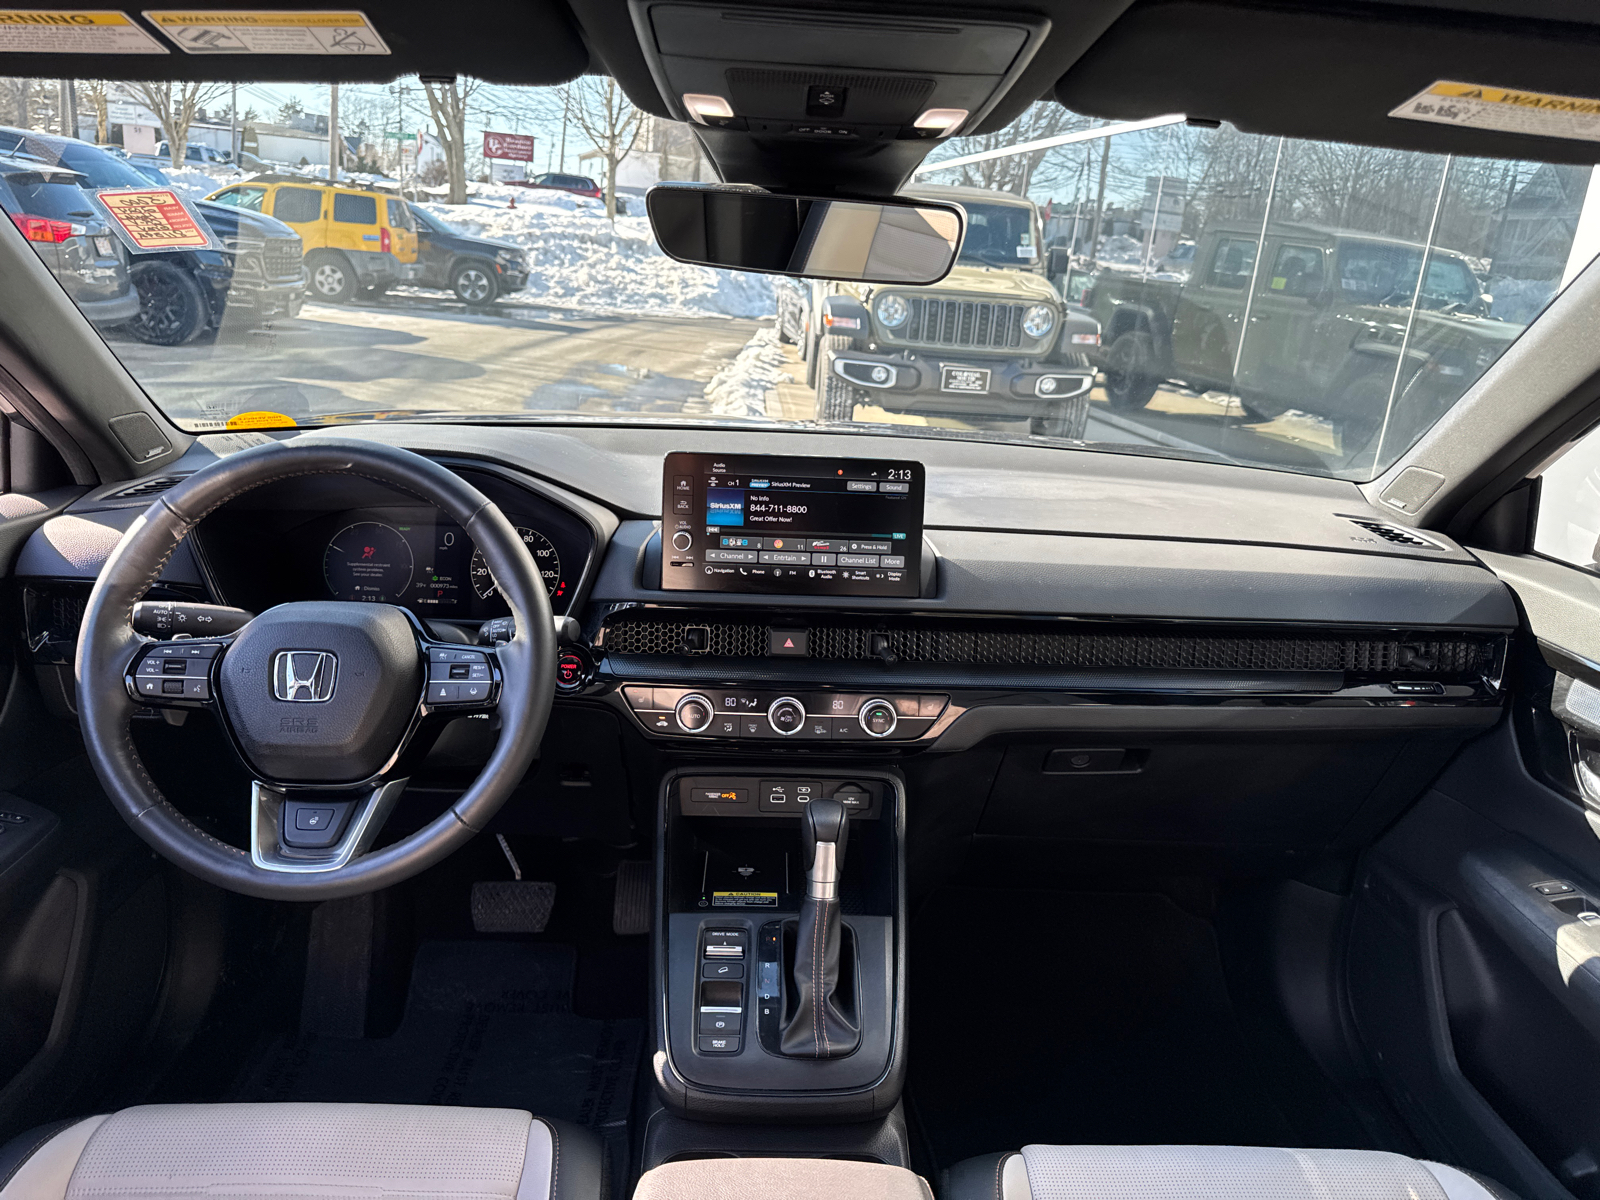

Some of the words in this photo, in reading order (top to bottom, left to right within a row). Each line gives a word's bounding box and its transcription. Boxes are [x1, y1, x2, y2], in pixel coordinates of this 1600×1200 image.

[178, 15, 258, 24] WARNING
[887, 469, 912, 480] 2:13
[749, 504, 808, 514] 844-711-8800
[444, 532, 455, 546] 0
[523, 535, 534, 543] 80
[536, 549, 550, 557] 100
[720, 552, 744, 560] Channel
[840, 556, 865, 564] Channel
[476, 568, 488, 576] 20
[541, 570, 554, 578] 120
[724, 697, 737, 707] 80
[832, 700, 844, 709] 80
[280, 717, 318, 727] SRS
